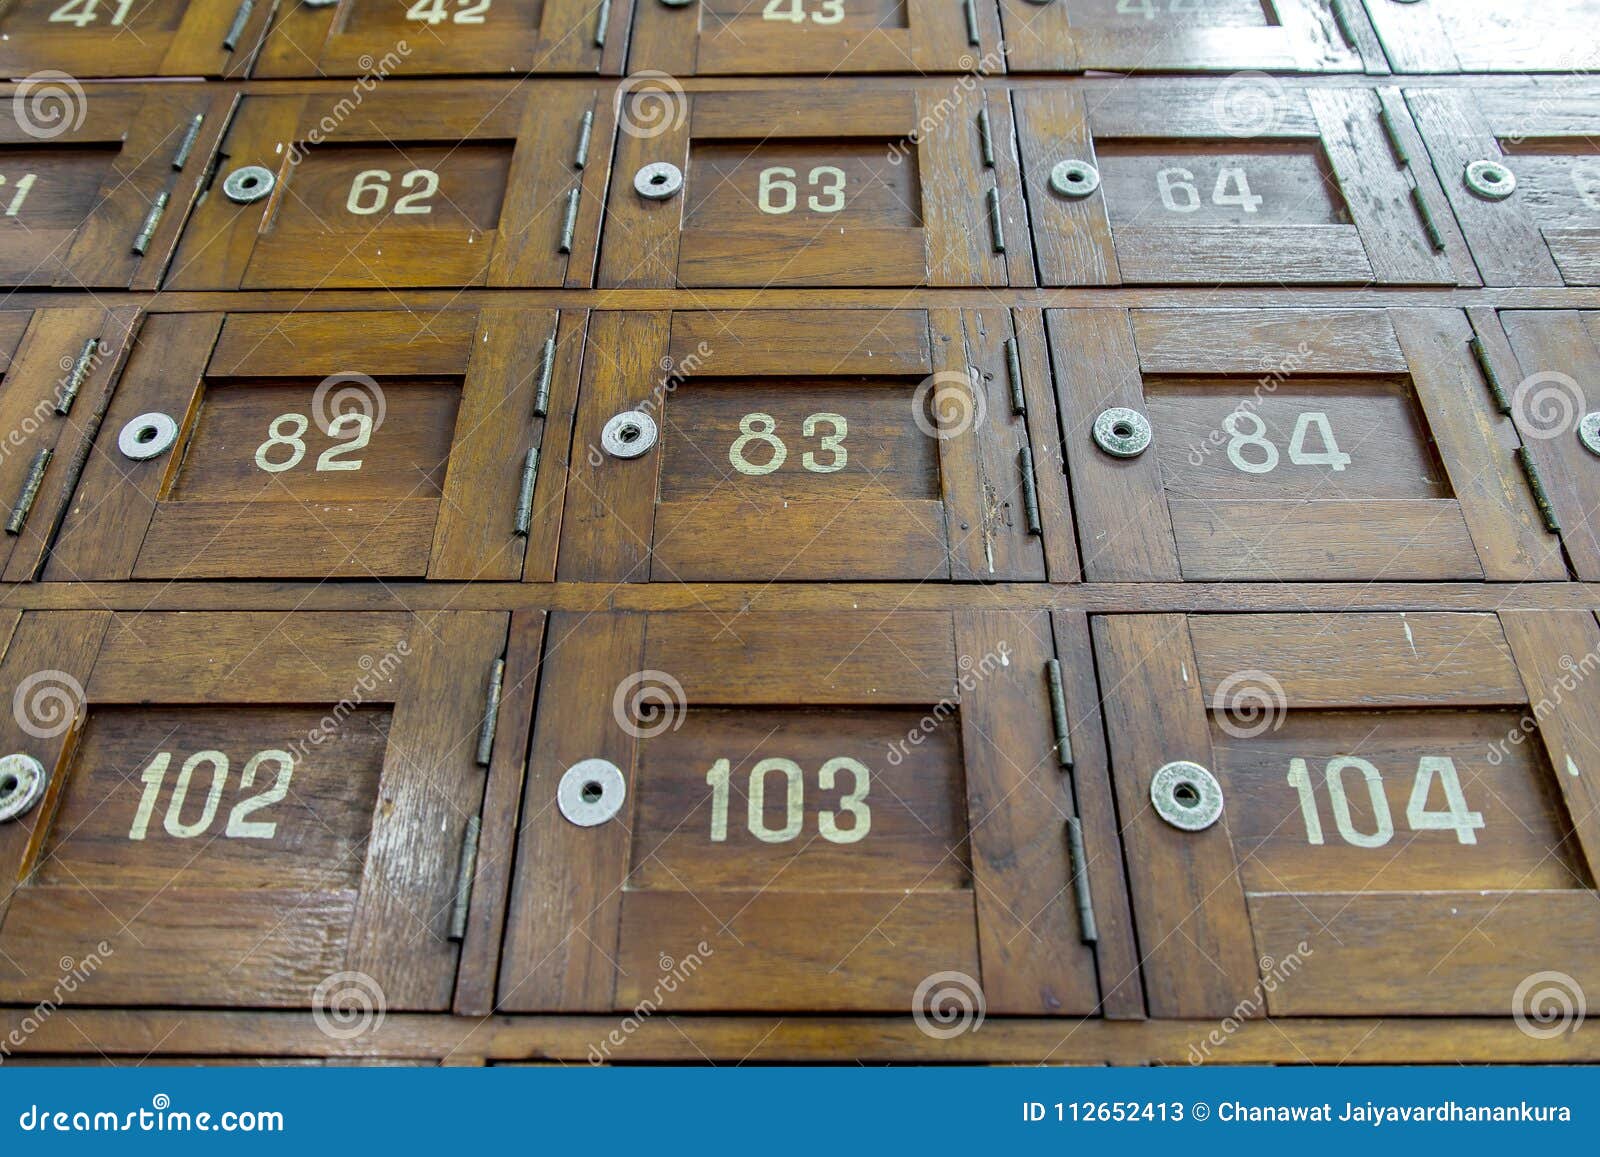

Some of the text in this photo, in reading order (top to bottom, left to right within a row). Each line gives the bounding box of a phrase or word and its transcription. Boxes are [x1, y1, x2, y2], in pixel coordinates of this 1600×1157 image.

[49, 0, 133, 27] 41
[406, 0, 492, 24] 42
[762, 0, 845, 25] 43
[0, 173, 38, 216] 1
[346, 168, 440, 215] 62
[758, 165, 847, 215] 63
[1156, 167, 1263, 213] 64
[254, 412, 374, 473] 82
[728, 412, 849, 476] 83
[1225, 411, 1352, 474] 84
[128, 749, 303, 841] 102
[706, 756, 872, 844] 103
[1286, 755, 1485, 849] 104
